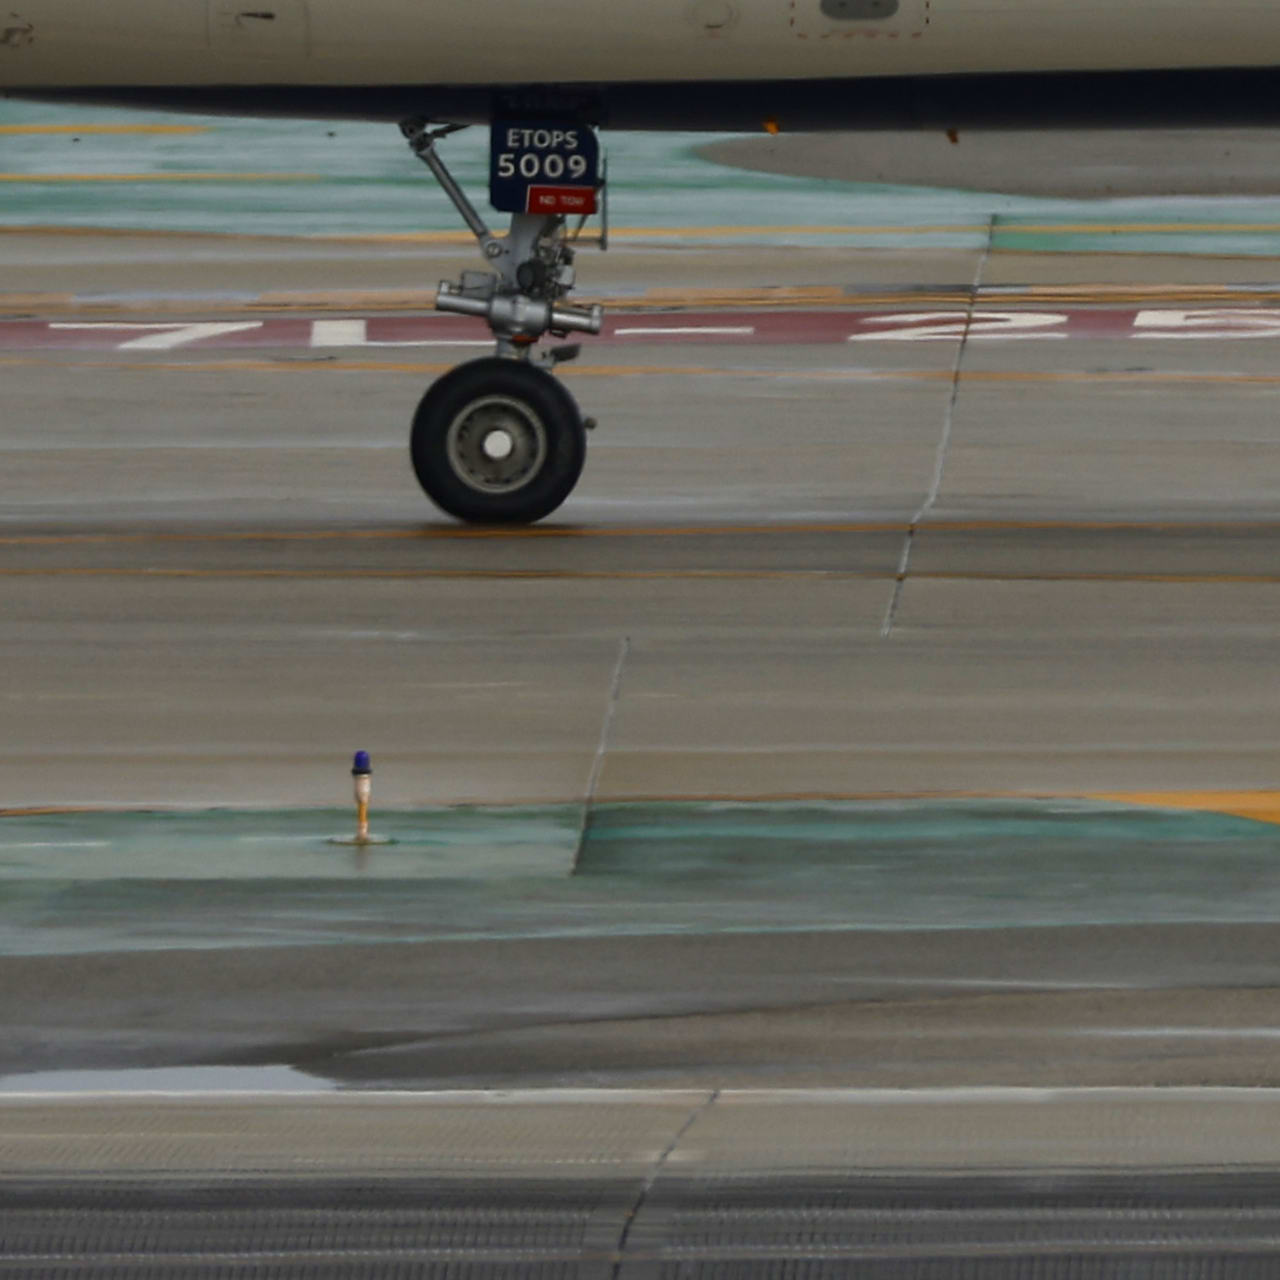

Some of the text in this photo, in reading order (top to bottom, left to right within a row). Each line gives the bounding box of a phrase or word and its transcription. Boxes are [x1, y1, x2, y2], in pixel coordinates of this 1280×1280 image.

[506, 128, 579, 149] ETOPS
[498, 153, 588, 179] 5009
[539, 194, 586, 206] NO TOW
